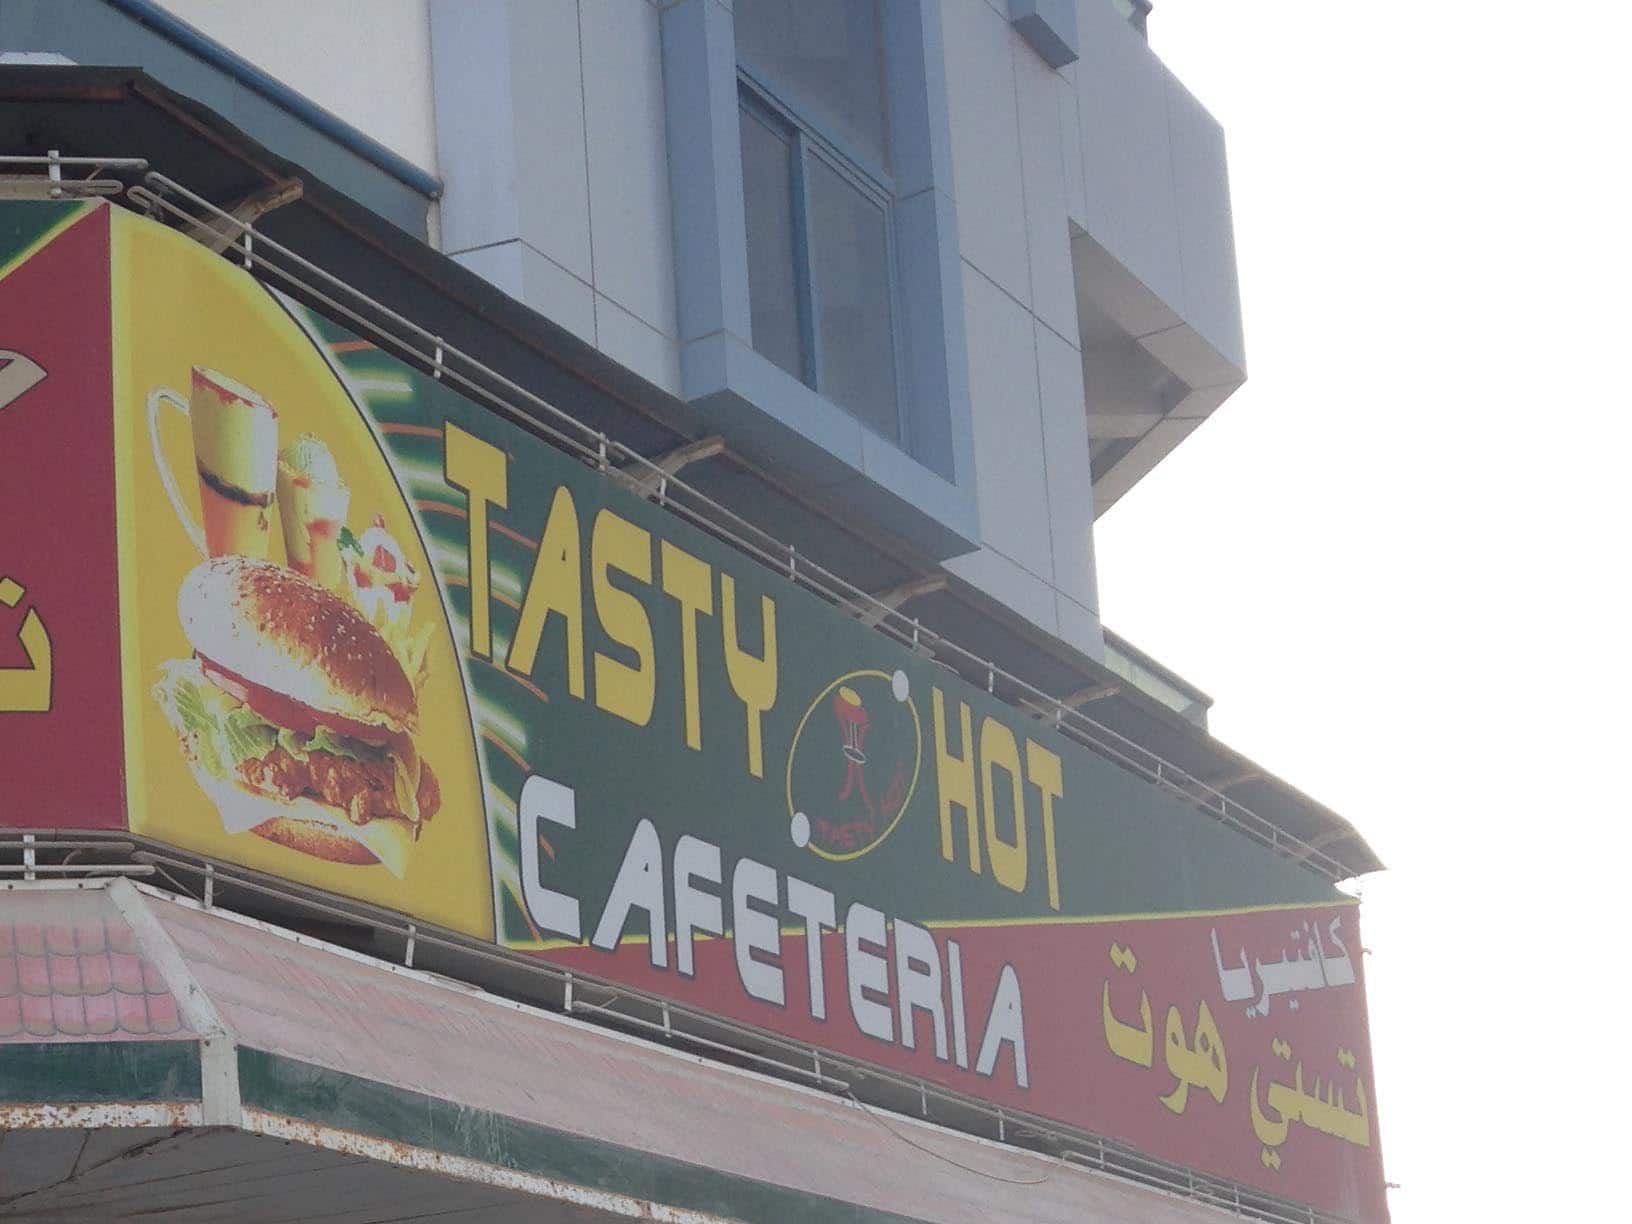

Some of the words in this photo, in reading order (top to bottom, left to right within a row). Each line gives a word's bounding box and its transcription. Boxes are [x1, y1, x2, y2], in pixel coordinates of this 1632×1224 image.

[443, 421, 780, 780] TASTY
[932, 686, 1064, 911] HOT
[519, 772, 1030, 1090] CAFETERIA
[1102, 942, 1228, 1115] هوت
[1250, 1036, 1369, 1172] تستي
